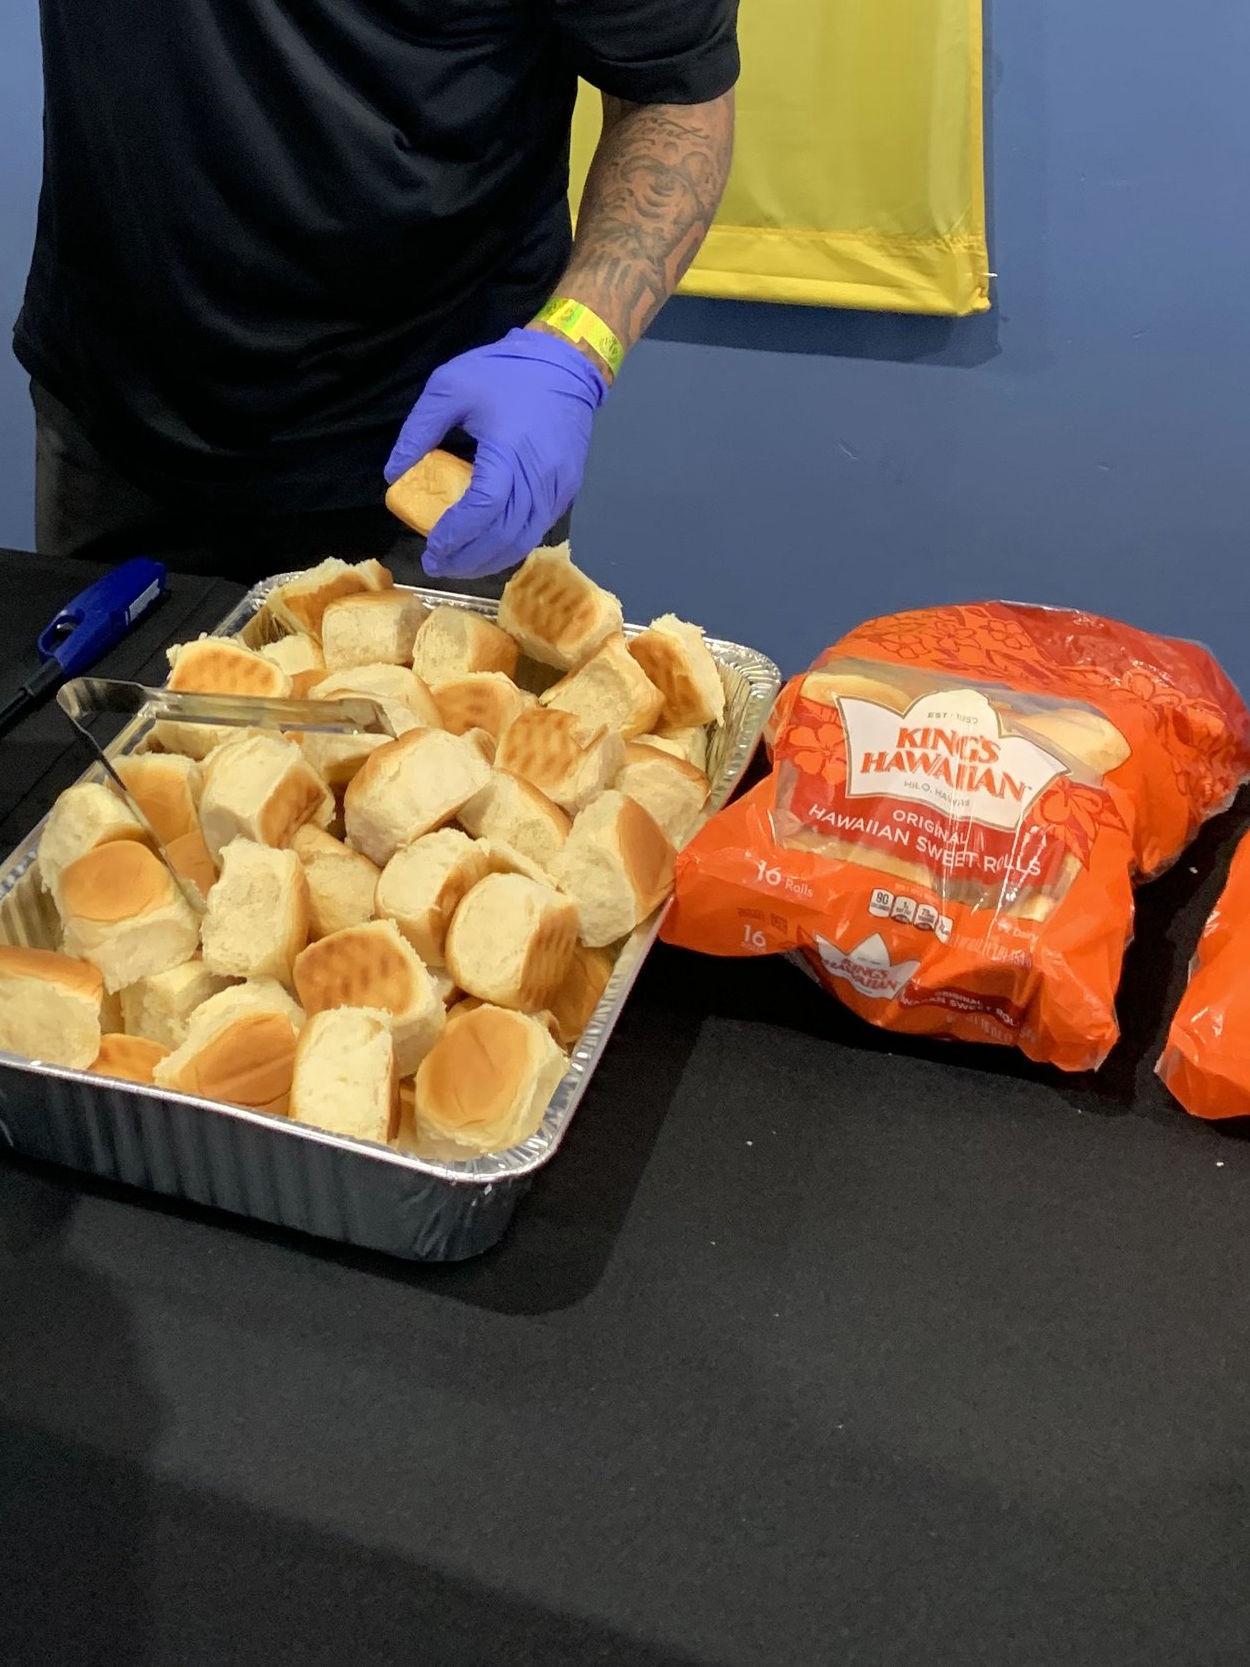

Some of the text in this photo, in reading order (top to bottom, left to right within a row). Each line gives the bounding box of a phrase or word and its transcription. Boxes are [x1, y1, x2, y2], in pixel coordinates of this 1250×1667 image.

[896, 726, 1001, 764] KING'S
[860, 751, 1027, 803] HAWAIIAN
[808, 803, 1042, 877] HAWAIIAN SWEET ROLLS
[892, 809, 969, 846] ORIGINAL
[756, 860, 814, 897] 16 Rolls
[876, 891, 890, 906] 90
[743, 924, 767, 947] 16
